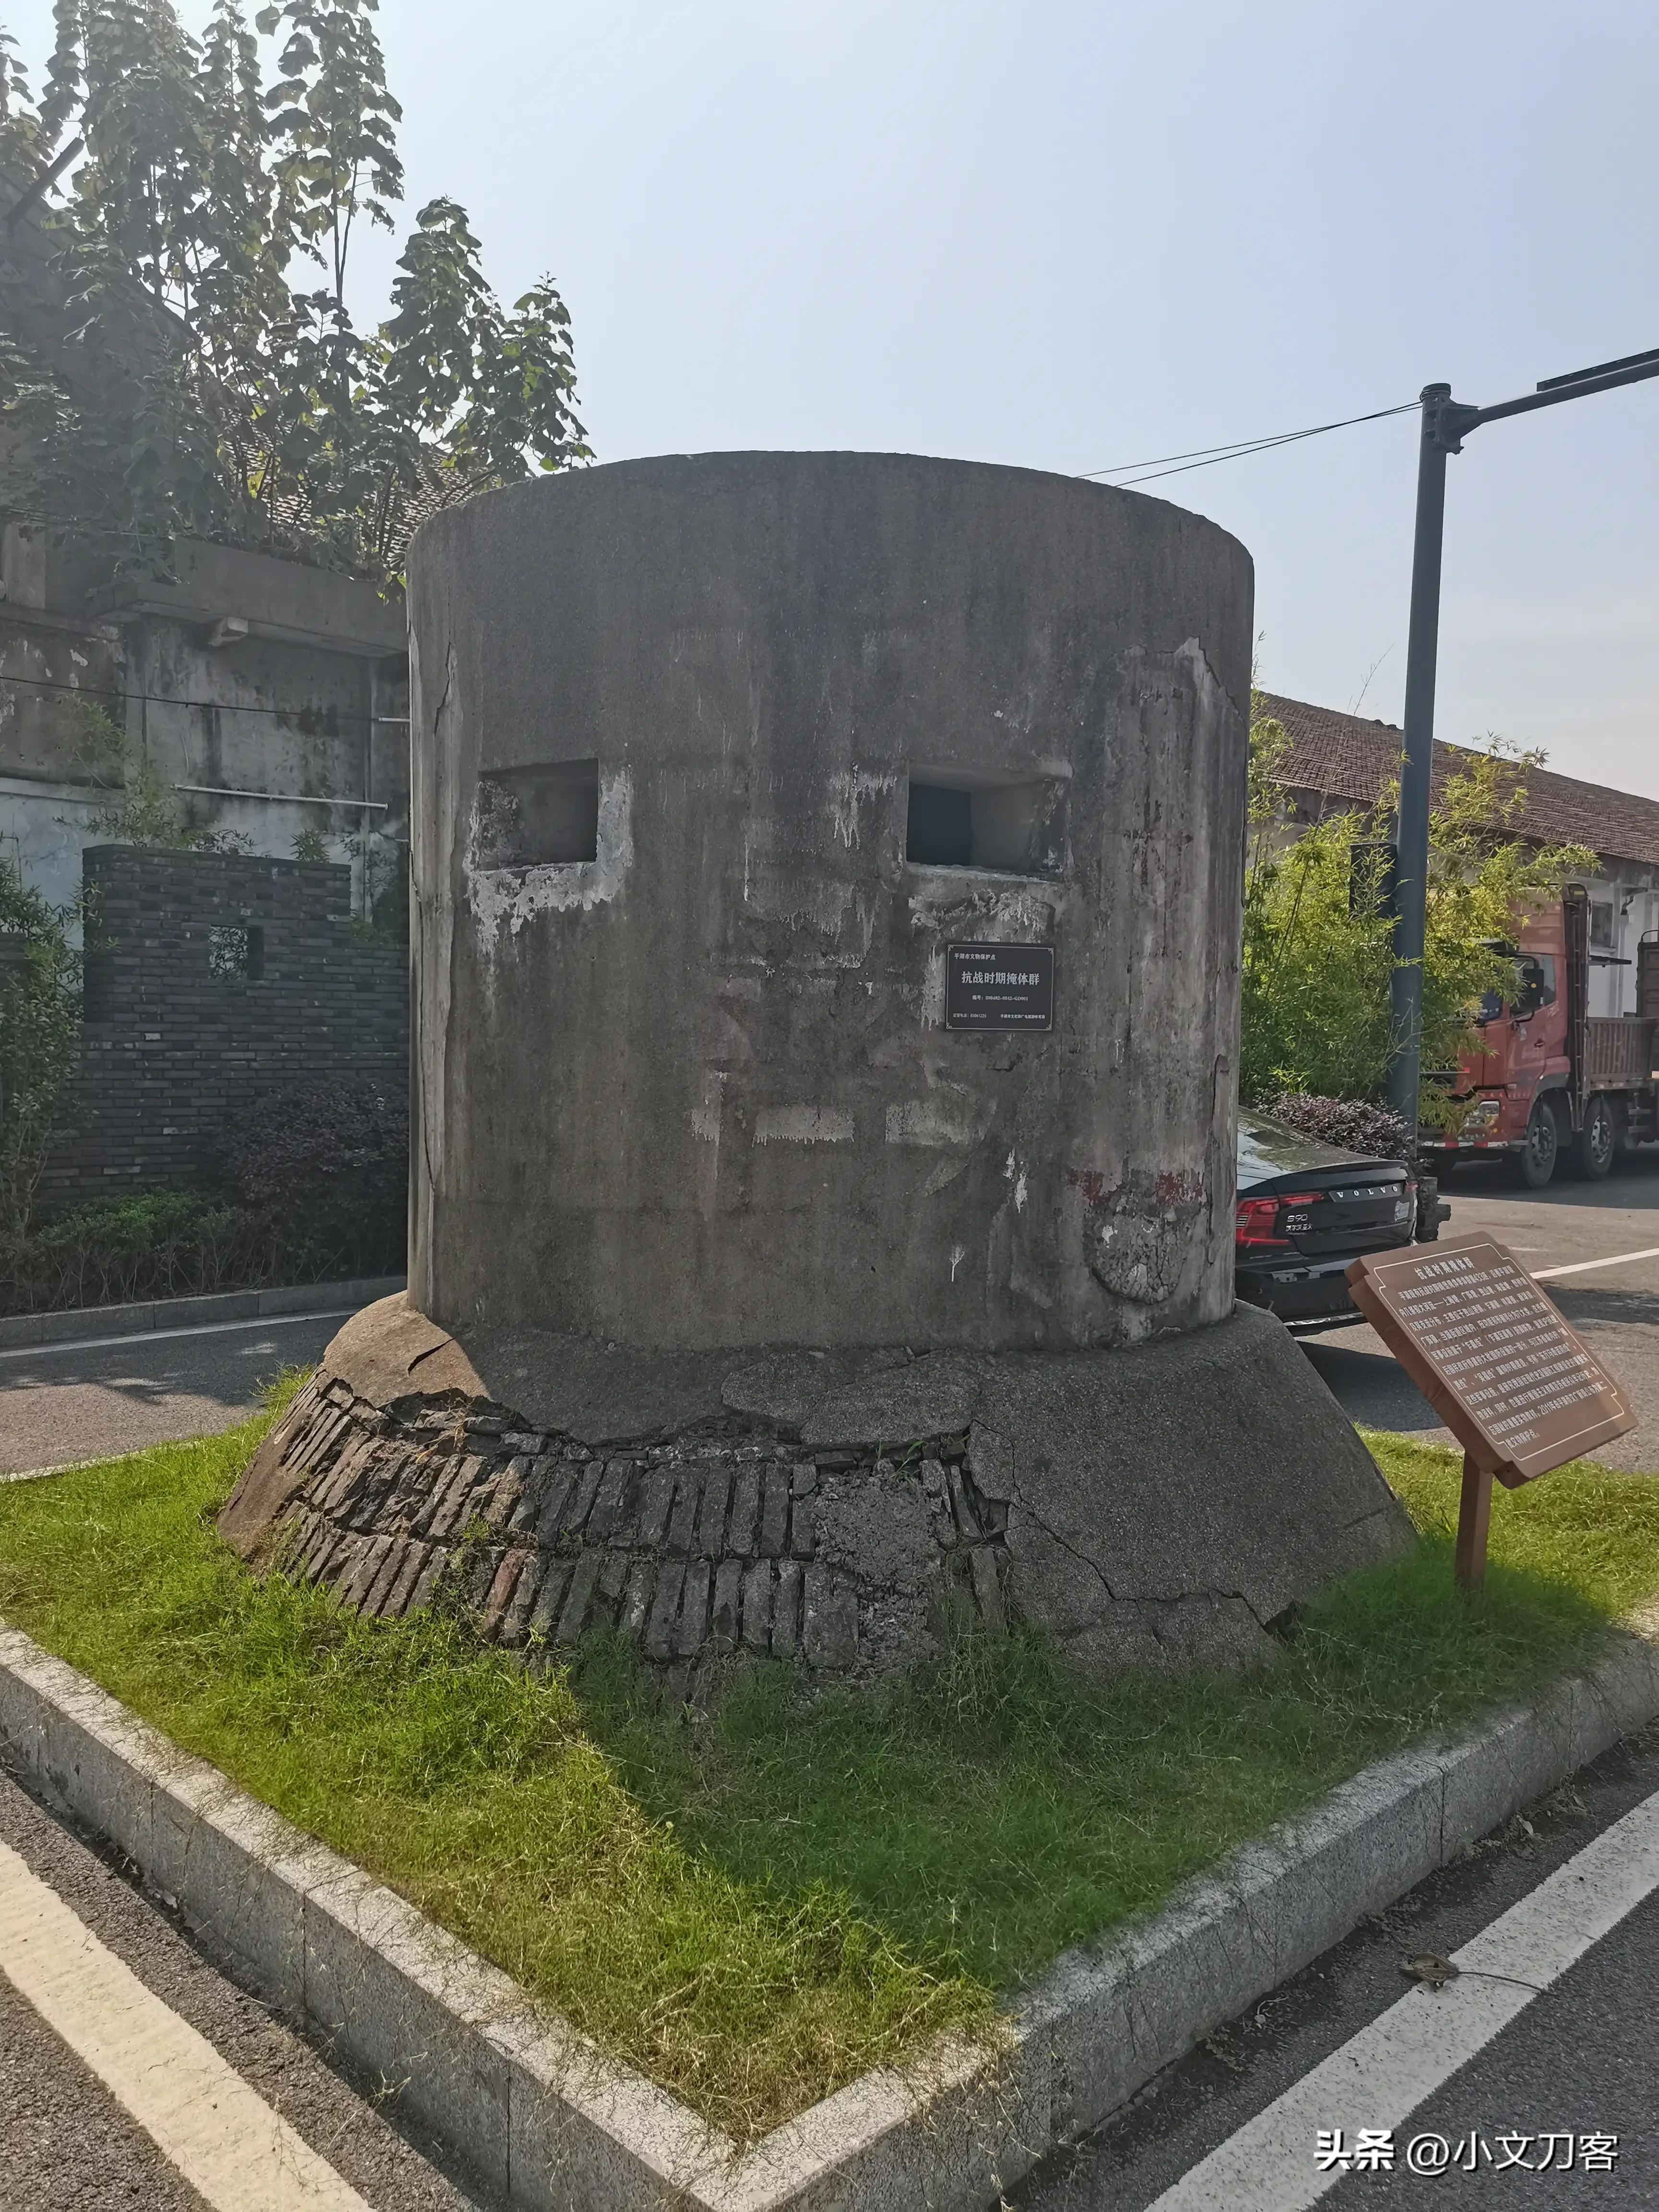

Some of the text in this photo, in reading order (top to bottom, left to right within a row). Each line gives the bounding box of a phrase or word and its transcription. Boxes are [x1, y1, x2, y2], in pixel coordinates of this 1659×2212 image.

[962, 971, 1040, 986] 抗战时期掩体群
[1336, 1185, 1398, 1199] VOLVO
[1287, 1214, 1308, 1223] S90
[1413, 1256, 1474, 1280] 抗战时期掩体群
[1504, 1427, 1540, 1449] 批文物保护点。
